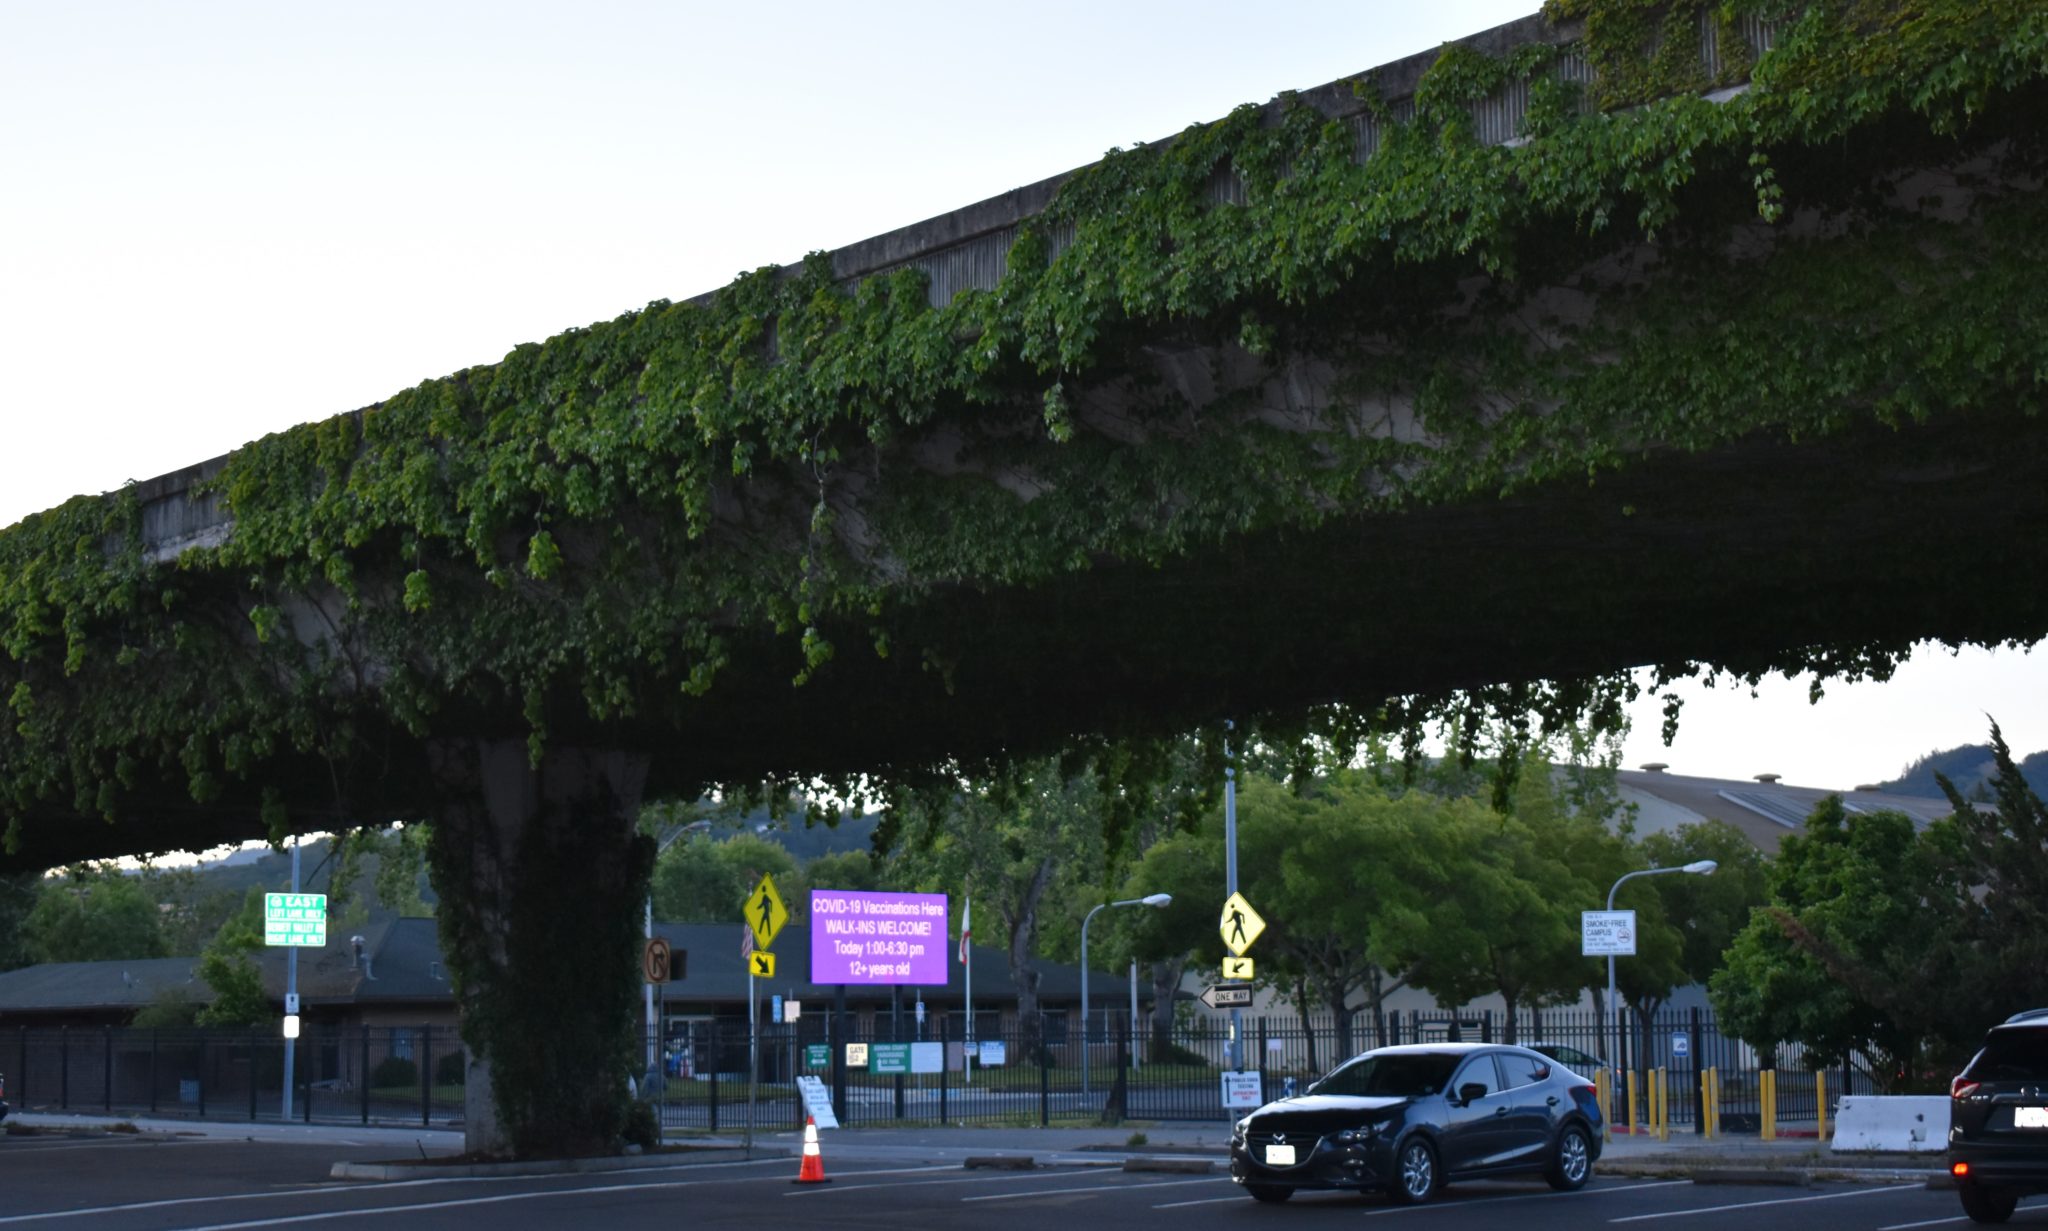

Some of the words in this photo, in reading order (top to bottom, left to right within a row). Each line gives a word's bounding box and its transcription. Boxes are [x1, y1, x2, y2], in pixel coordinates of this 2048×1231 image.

[285, 895, 319, 908] EAST
[812, 898, 861, 914] COVID-19
[862, 900, 920, 915] Vaccinations
[921, 901, 944, 916] Here
[825, 919, 876, 934] WALK-INS
[877, 920, 932, 936] WELCOME!
[1585, 919, 1627, 928] SMOKE-FREE
[1585, 928, 1612, 936] CAMPUS
[834, 939, 864, 958] Today
[866, 941, 908, 955] 1:00-6:30
[909, 943, 925, 958] pm
[849, 961, 868, 976] 12+
[869, 963, 894, 979] years
[895, 961, 910, 976] old
[1215, 992, 1231, 1002] ONE
[1233, 991, 1248, 1001] WAY
[849, 1046, 865, 1055] GATE
